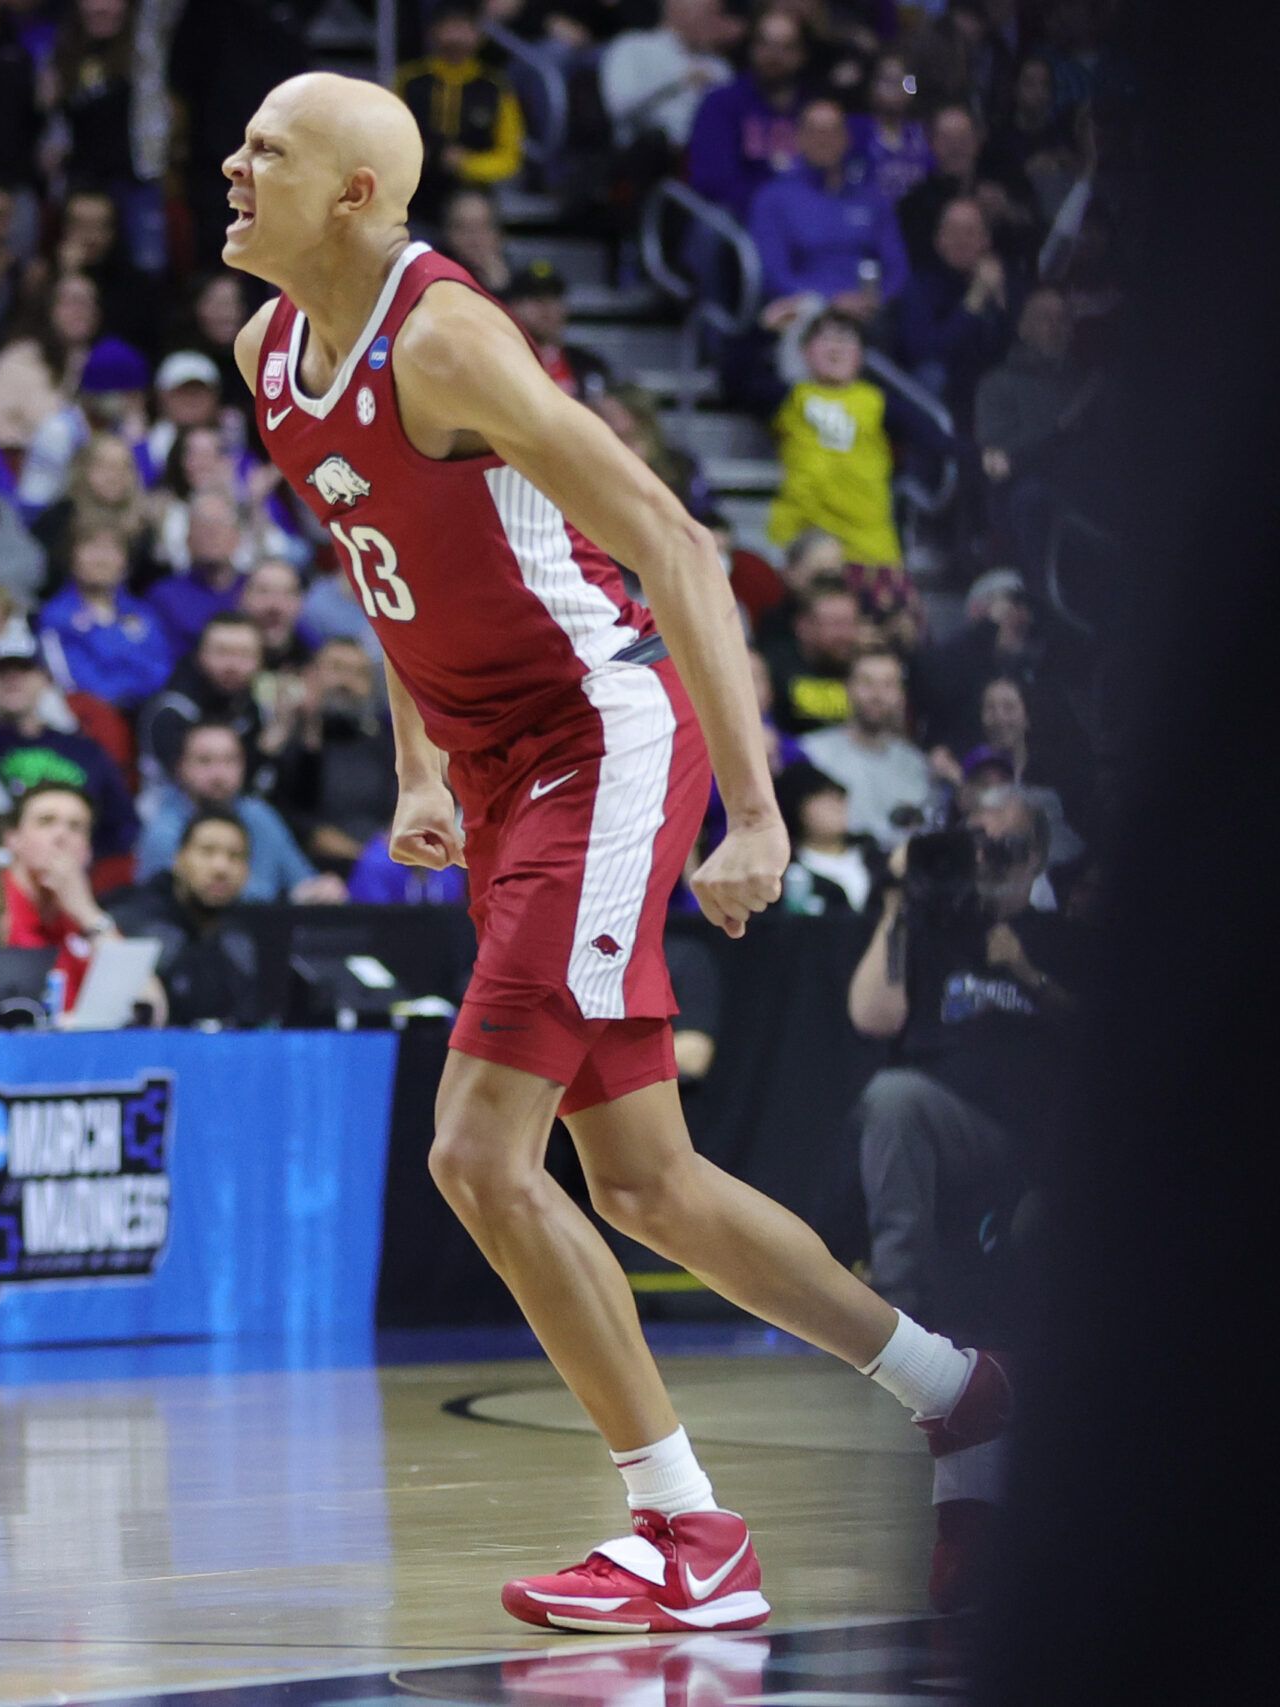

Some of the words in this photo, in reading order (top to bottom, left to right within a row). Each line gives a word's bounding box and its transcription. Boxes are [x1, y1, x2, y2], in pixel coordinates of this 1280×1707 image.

[329, 520, 416, 621] 13
[8, 1099, 122, 1179] MARCH
[22, 1174, 170, 1257] MADNESS
